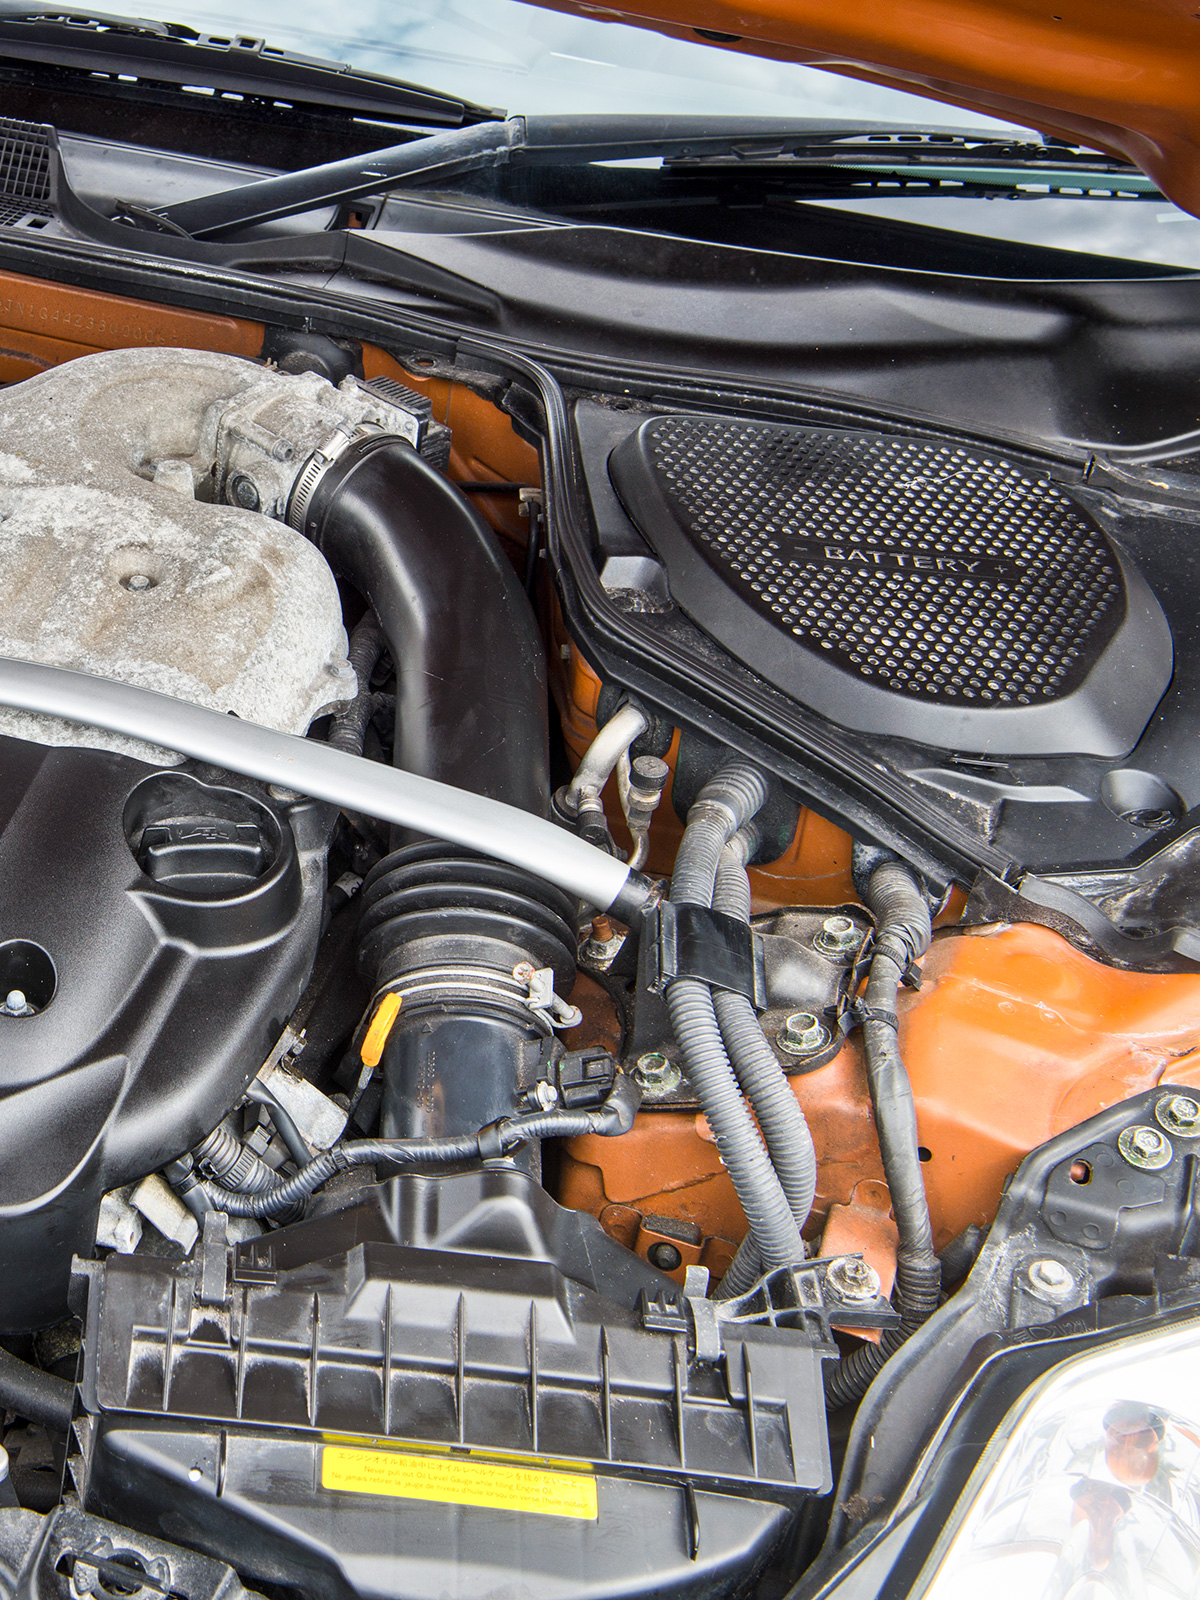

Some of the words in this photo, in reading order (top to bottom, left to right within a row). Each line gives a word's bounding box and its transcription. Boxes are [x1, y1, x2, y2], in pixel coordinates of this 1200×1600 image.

[824, 545, 980, 573] BATTERY
[332, 1471, 341, 1480] Ne
[345, 1473, 367, 1483] jamais
[370, 1476, 391, 1486] retirer
[395, 1479, 401, 1487] la
[404, 1480, 423, 1490] jauge
[426, 1483, 434, 1491] de
[437, 1484, 459, 1495] niveau
[520, 1494, 539, 1504] verse
[364, 1465, 384, 1475] Never
[388, 1468, 400, 1477] pull
[402, 1470, 414, 1479] out
[417, 1472, 425, 1480] Oil
[428, 1473, 448, 1483] Level
[450, 1476, 472, 1486] Gauge
[476, 1479, 492, 1489] while
[516, 1484, 540, 1494] Engine
